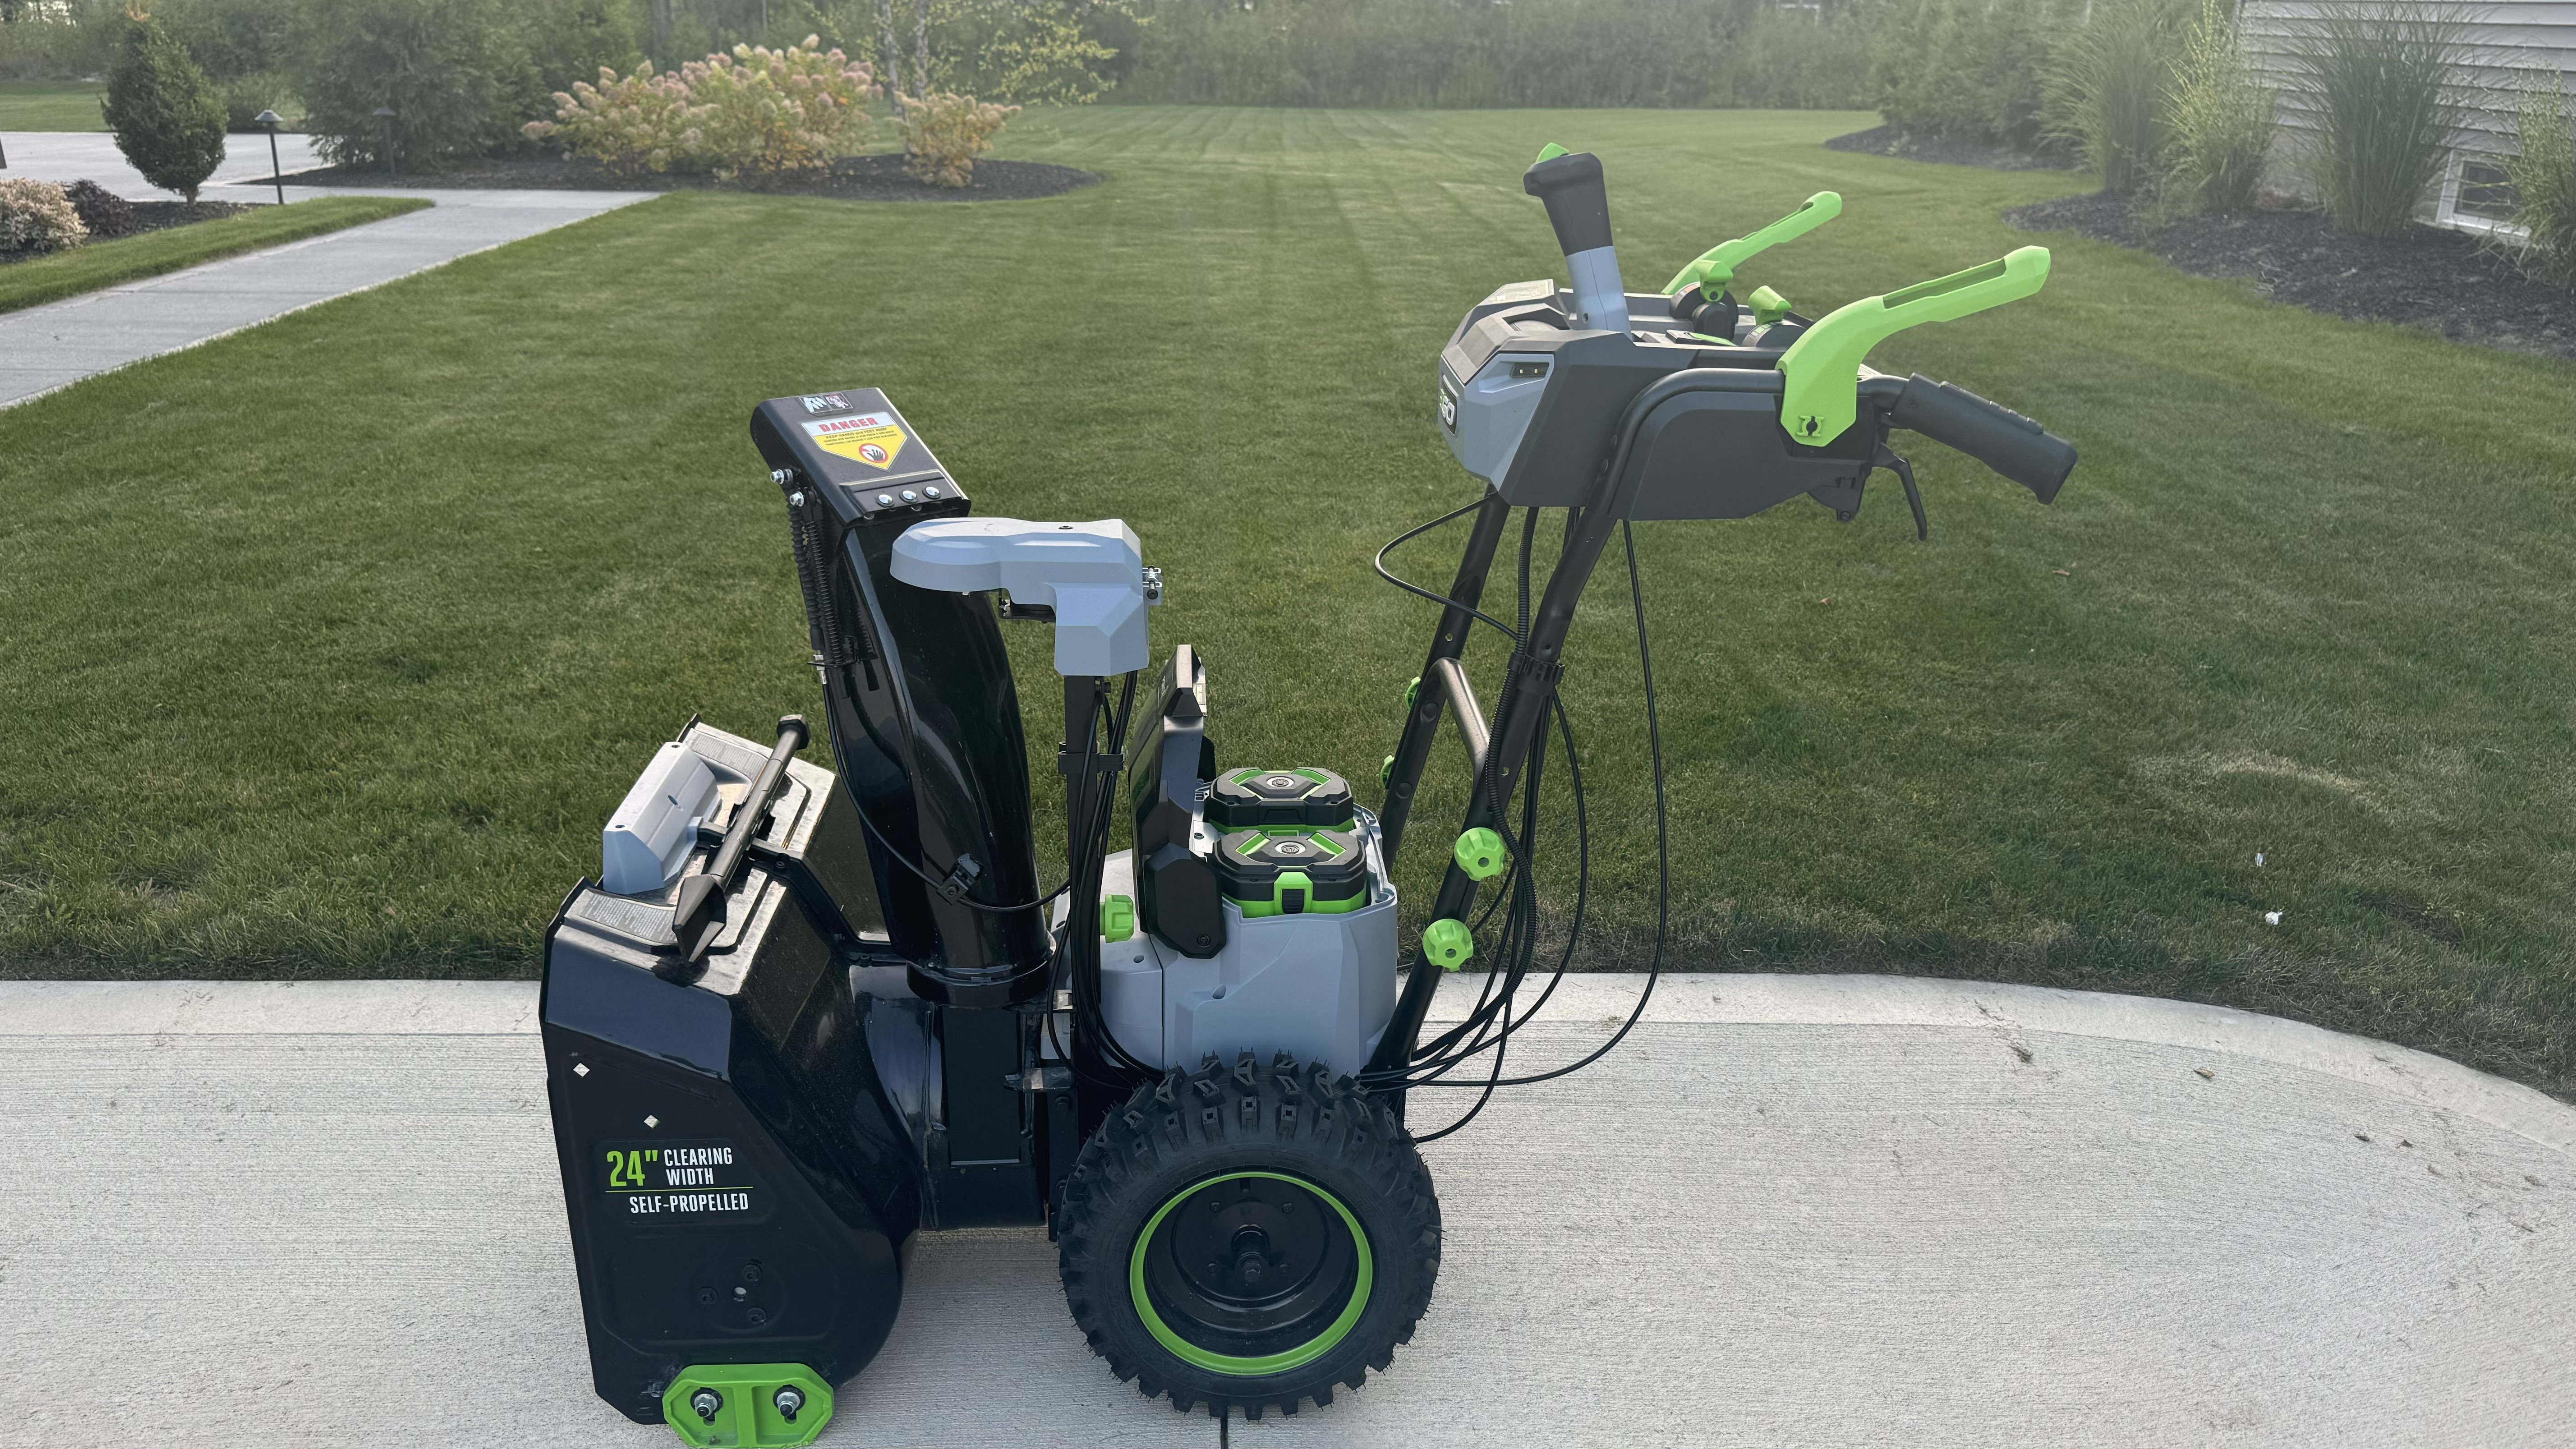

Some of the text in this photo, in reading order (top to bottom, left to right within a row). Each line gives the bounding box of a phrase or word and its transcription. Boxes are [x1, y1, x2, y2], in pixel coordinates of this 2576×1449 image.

[818, 417, 879, 432] DANGER
[607, 1147, 732, 1187] 24" CLEARING
[666, 1168, 714, 1186] WIDTH
[629, 1193, 749, 1214] SELF-PROPELLED
